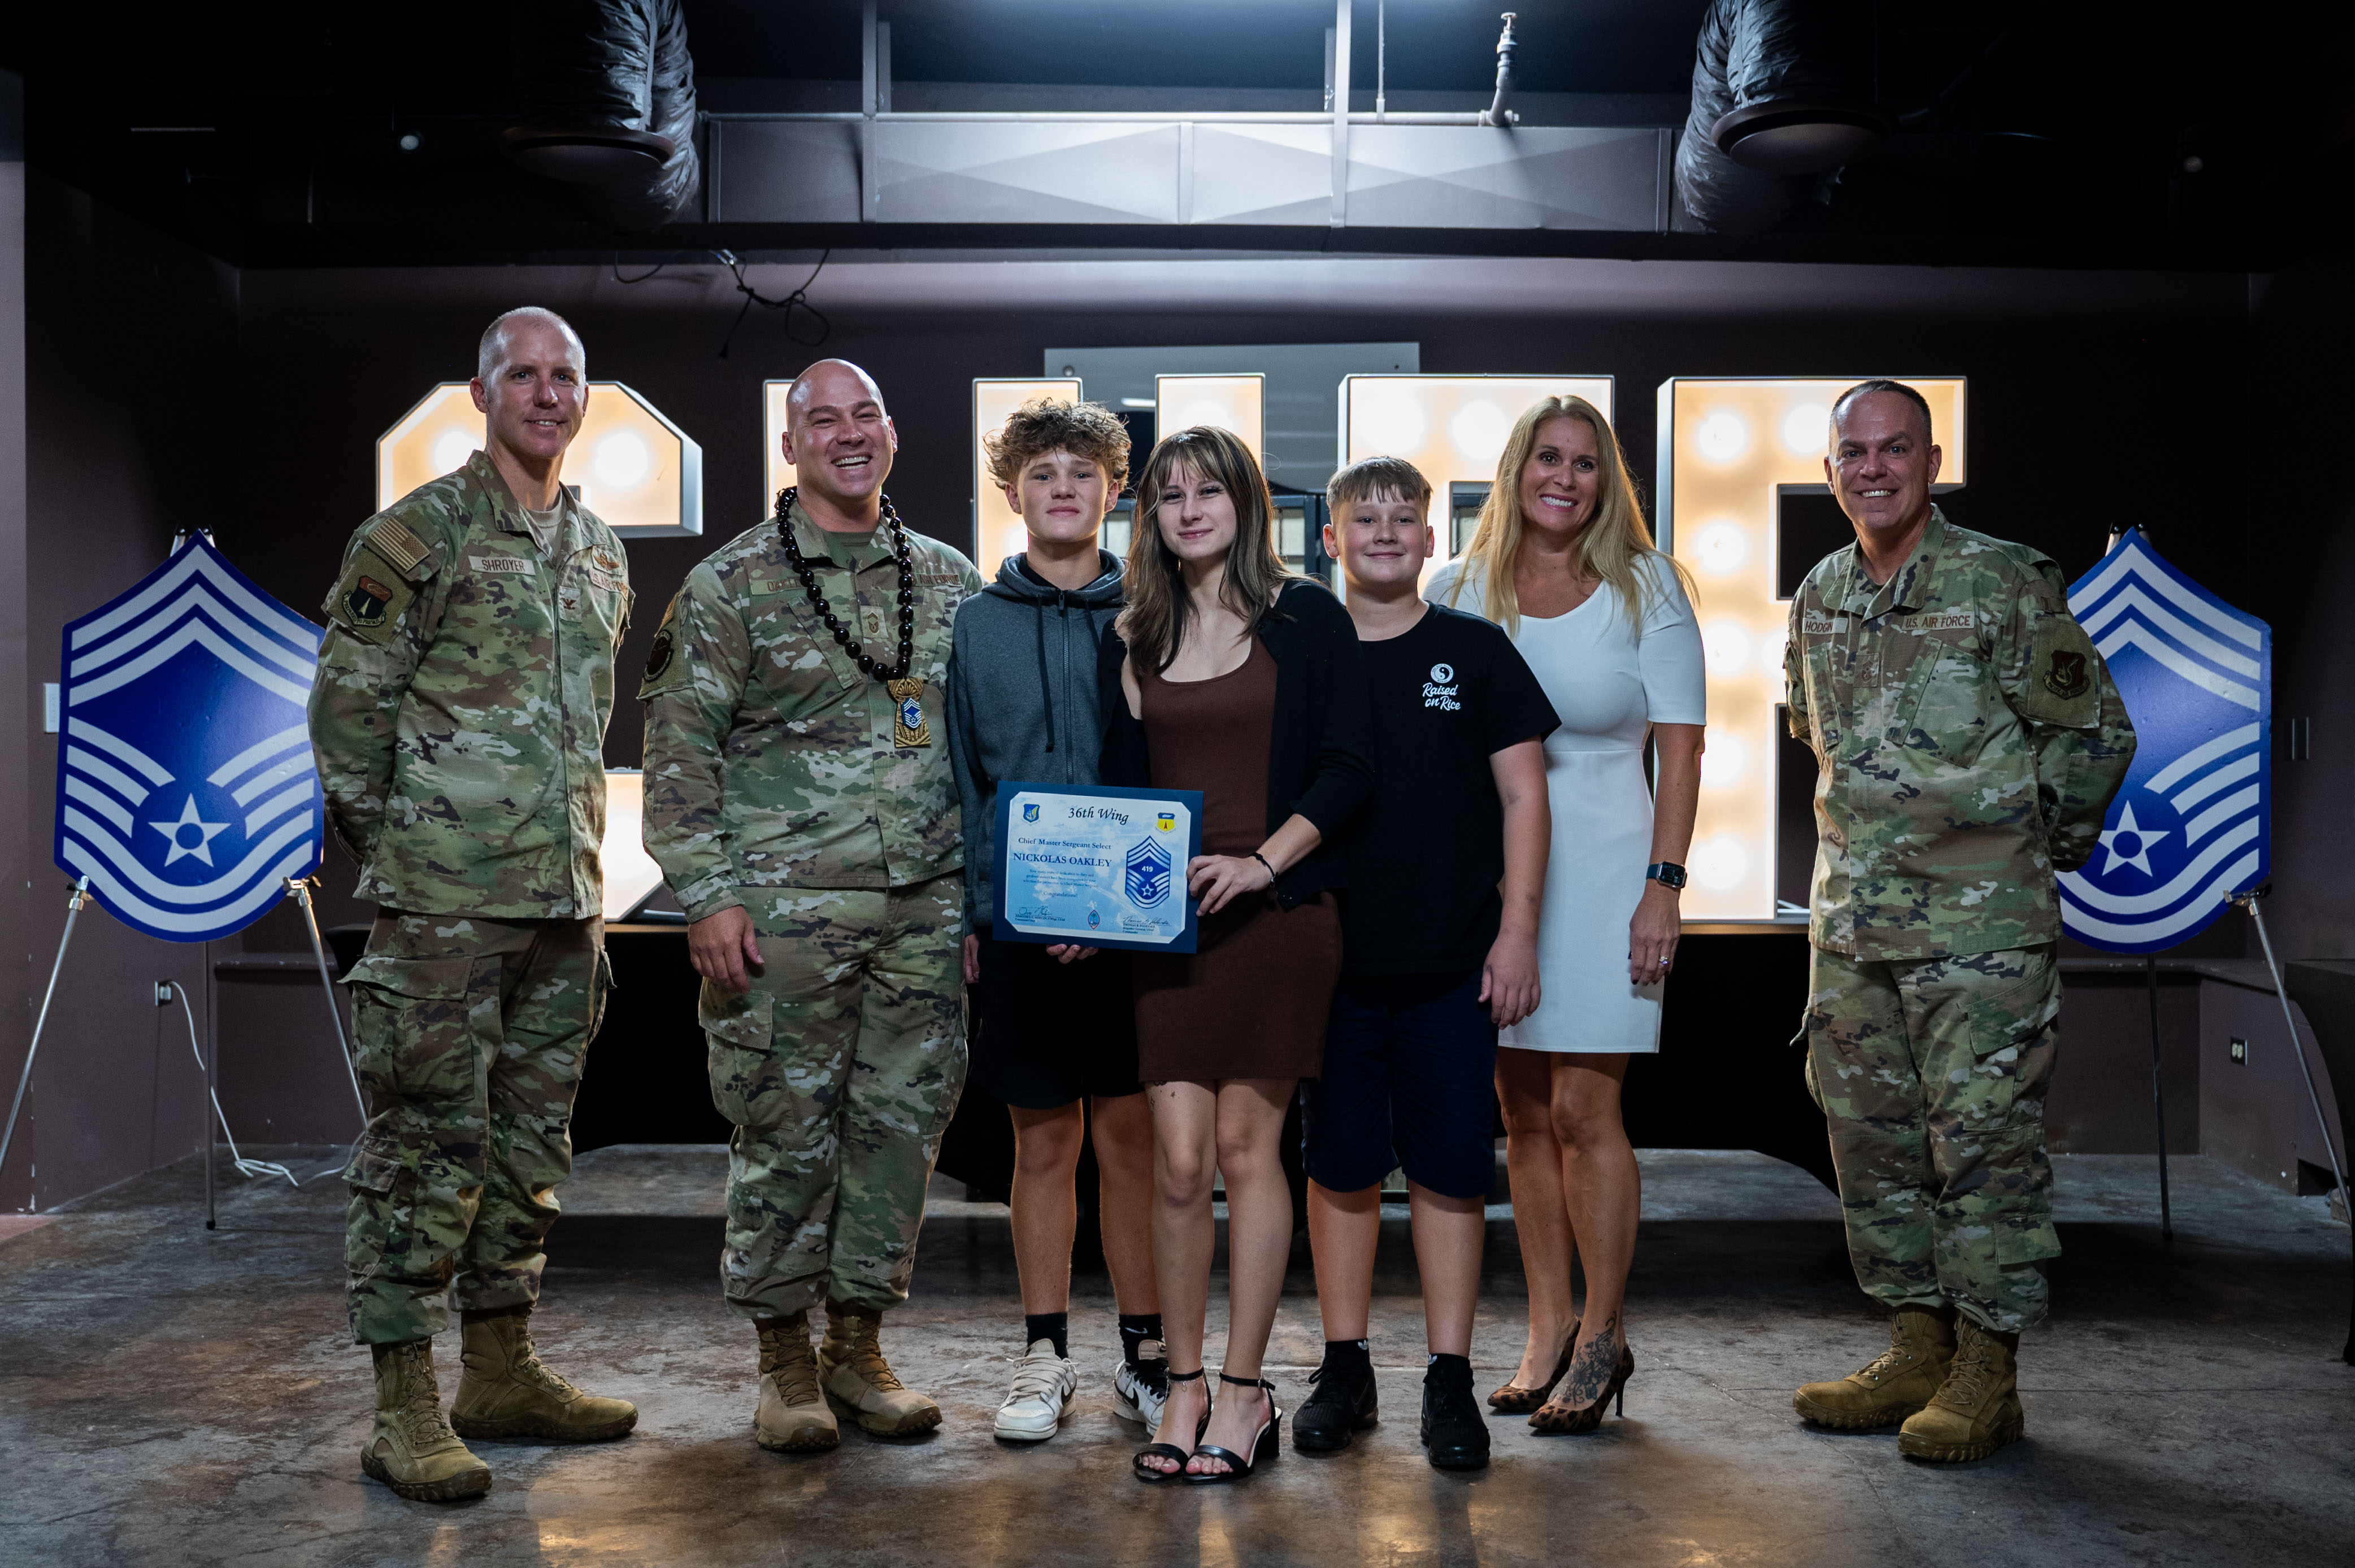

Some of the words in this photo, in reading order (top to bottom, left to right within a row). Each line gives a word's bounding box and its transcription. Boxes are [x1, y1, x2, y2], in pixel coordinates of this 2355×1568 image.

[481, 559, 525, 572] SHROYER
[919, 574, 933, 585] AIR
[934, 574, 959, 585] FORCE
[1905, 618, 1918, 628] U.S.
[1921, 616, 1938, 628] AIR
[1941, 615, 1971, 627] FORCE
[1422, 682, 1458, 697] Raised
[1425, 698, 1440, 707] on
[1440, 695, 1461, 711] Rice
[1068, 806, 1094, 818] 36th
[1098, 808, 1129, 826] Wing
[1013, 853, 1067, 864] NICKOLAS
[1069, 857, 1112, 867] OAKLEY
